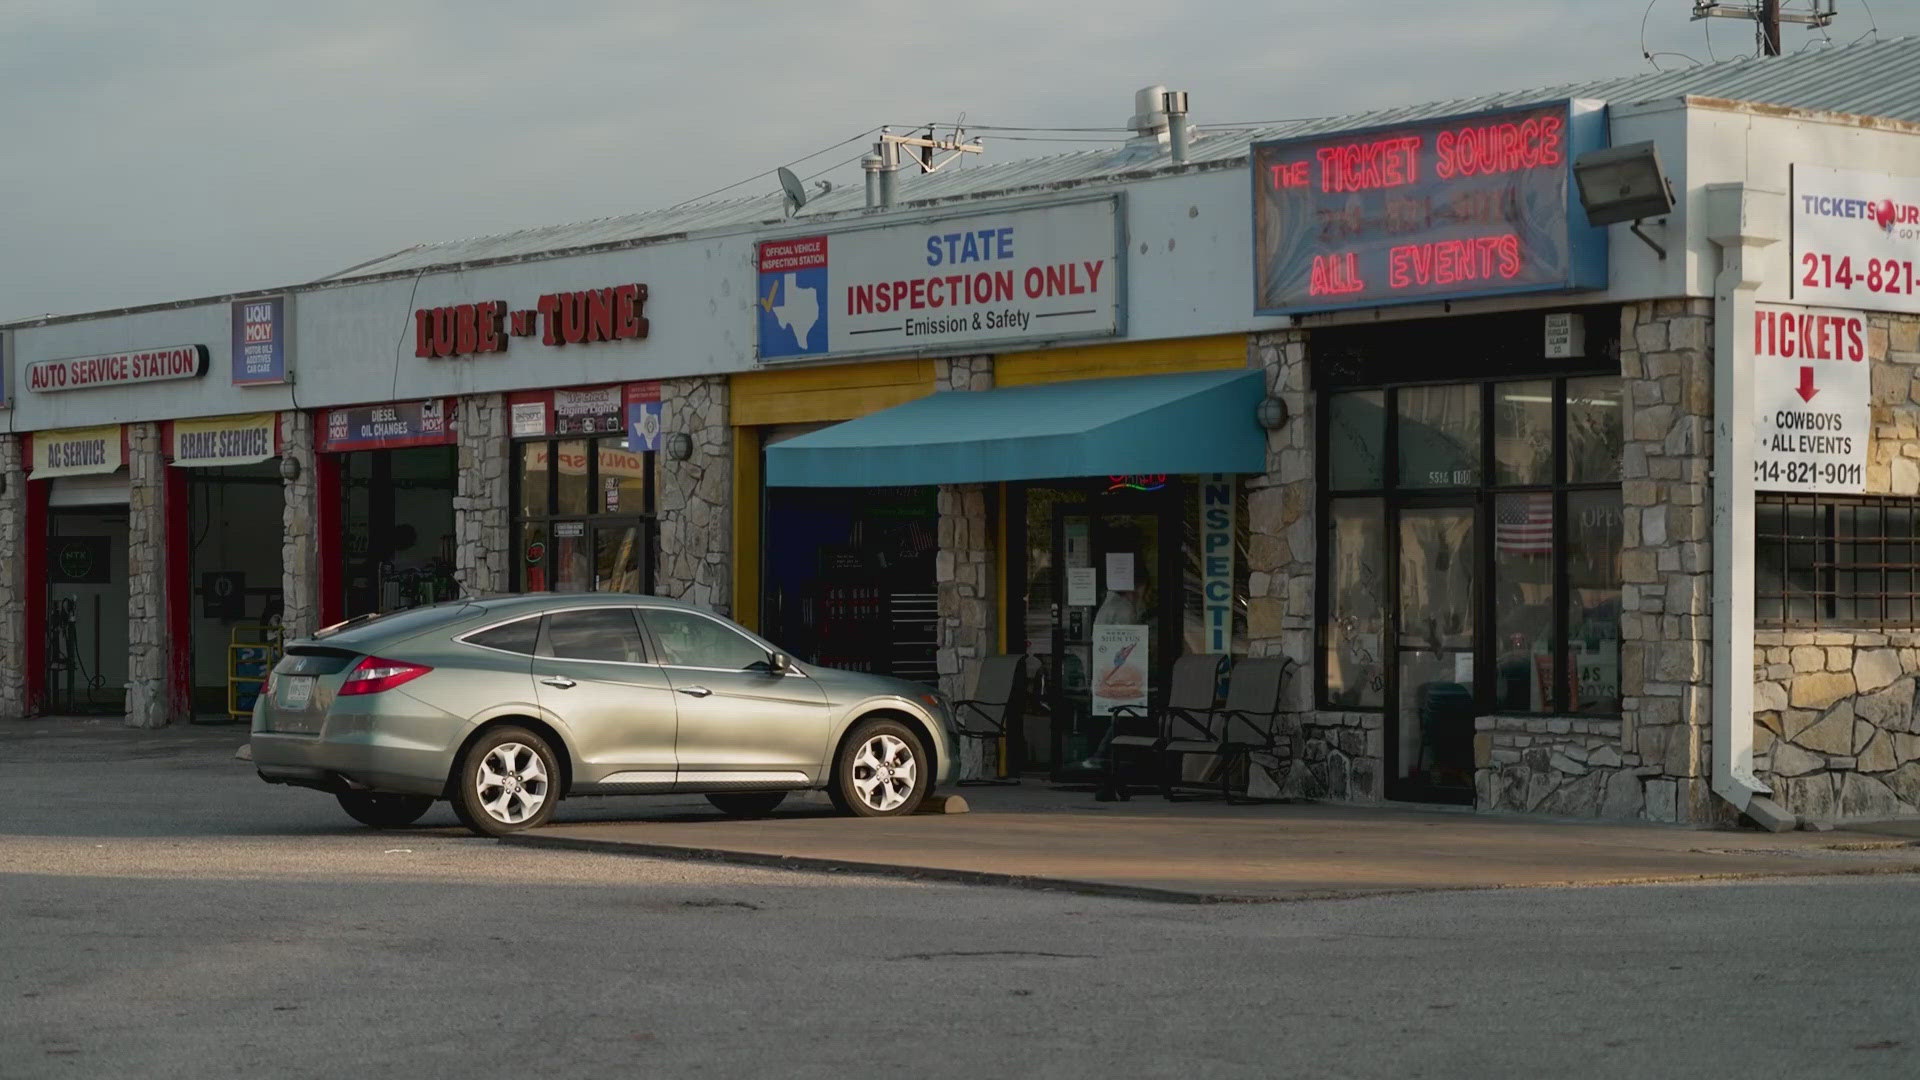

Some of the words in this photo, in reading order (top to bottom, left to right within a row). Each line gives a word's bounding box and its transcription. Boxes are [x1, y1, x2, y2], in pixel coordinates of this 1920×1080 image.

[1271, 161, 1310, 189] THE
[1317, 136, 1420, 193] TICKET
[1435, 117, 1561, 179] SOURCE
[1801, 195, 1920, 227] TICKETSOUR
[765, 246, 793, 257] OFFICIAL
[794, 242, 821, 254] VEHICLE
[927, 227, 1014, 267] STATE
[762, 257, 798, 270] INSPECTION
[799, 254, 825, 266] STATION
[1309, 252, 1364, 296] ALL
[1389, 234, 1520, 288] EVENTS
[848, 270, 1014, 315] INSPECTION
[1024, 260, 1104, 300] ONLY
[246, 305, 271, 322] LIQUI
[415, 300, 503, 358] LUBE
[537, 283, 643, 346] TUNE
[246, 323, 272, 341] MOLY
[905, 316, 967, 337] Emission
[971, 313, 982, 330] &
[986, 309, 1030, 330] Safety
[1754, 311, 1864, 362] TICKETS
[244, 345, 261, 355] MOTOR
[262, 344, 273, 353] OILS
[246, 354, 272, 364] ADDITIVES
[32, 363, 67, 389] AUTO
[71, 356, 128, 385] SERVICE
[132, 349, 193, 378] STATION
[247, 365, 257, 373] CAR
[258, 364, 271, 373] CARE
[583, 390, 609, 402] Check
[371, 408, 397, 422] DIESEL
[559, 404, 588, 417] Engine
[589, 403, 618, 416] Lights
[329, 413, 347, 426] LIQUI
[422, 418, 443, 431] MOLY
[1775, 411, 1842, 431] COWBOYS
[329, 425, 348, 438] MOLY
[361, 425, 373, 438] OIL
[374, 421, 408, 437] CHANGES
[180, 432, 217, 459] BRAKE
[219, 427, 268, 458] SERVICE
[1771, 434, 1796, 452] ALL
[1799, 435, 1852, 454] EVENTS
[48, 443, 62, 468] AC
[63, 438, 106, 467] SERVICE
